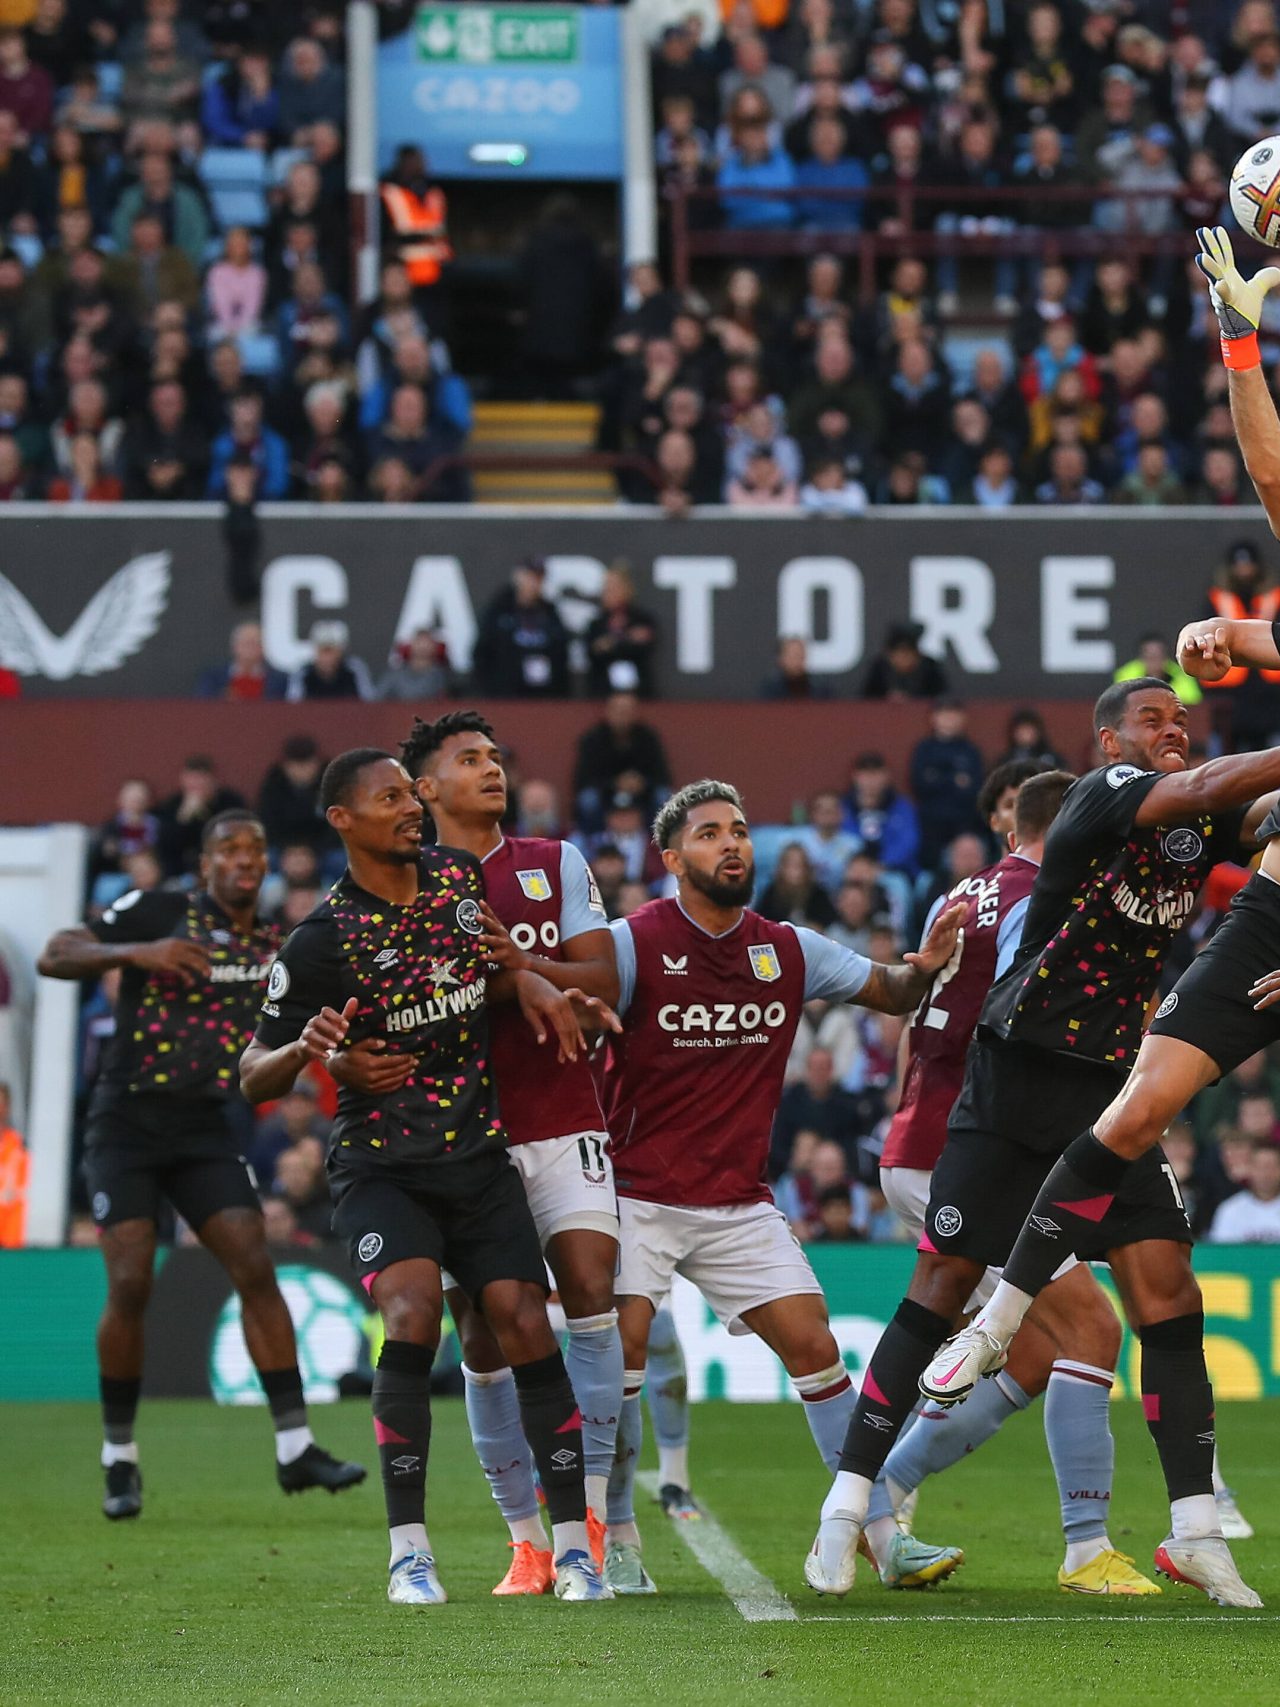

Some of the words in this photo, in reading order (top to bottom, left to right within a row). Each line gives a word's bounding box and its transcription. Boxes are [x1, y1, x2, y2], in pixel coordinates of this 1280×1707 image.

[498, 20, 572, 53] EXIT
[413, 78, 581, 114] CAZOO
[1112, 879, 1195, 925] HOLLYWD
[386, 977, 486, 1032] HOLLYWO
[658, 1001, 786, 1031] CAZOO
[673, 1038, 714, 1047] Search.
[741, 1034, 769, 1044] Smile
[581, 1414, 617, 1425] LLA
[1068, 1490, 1111, 1500] VILLA
